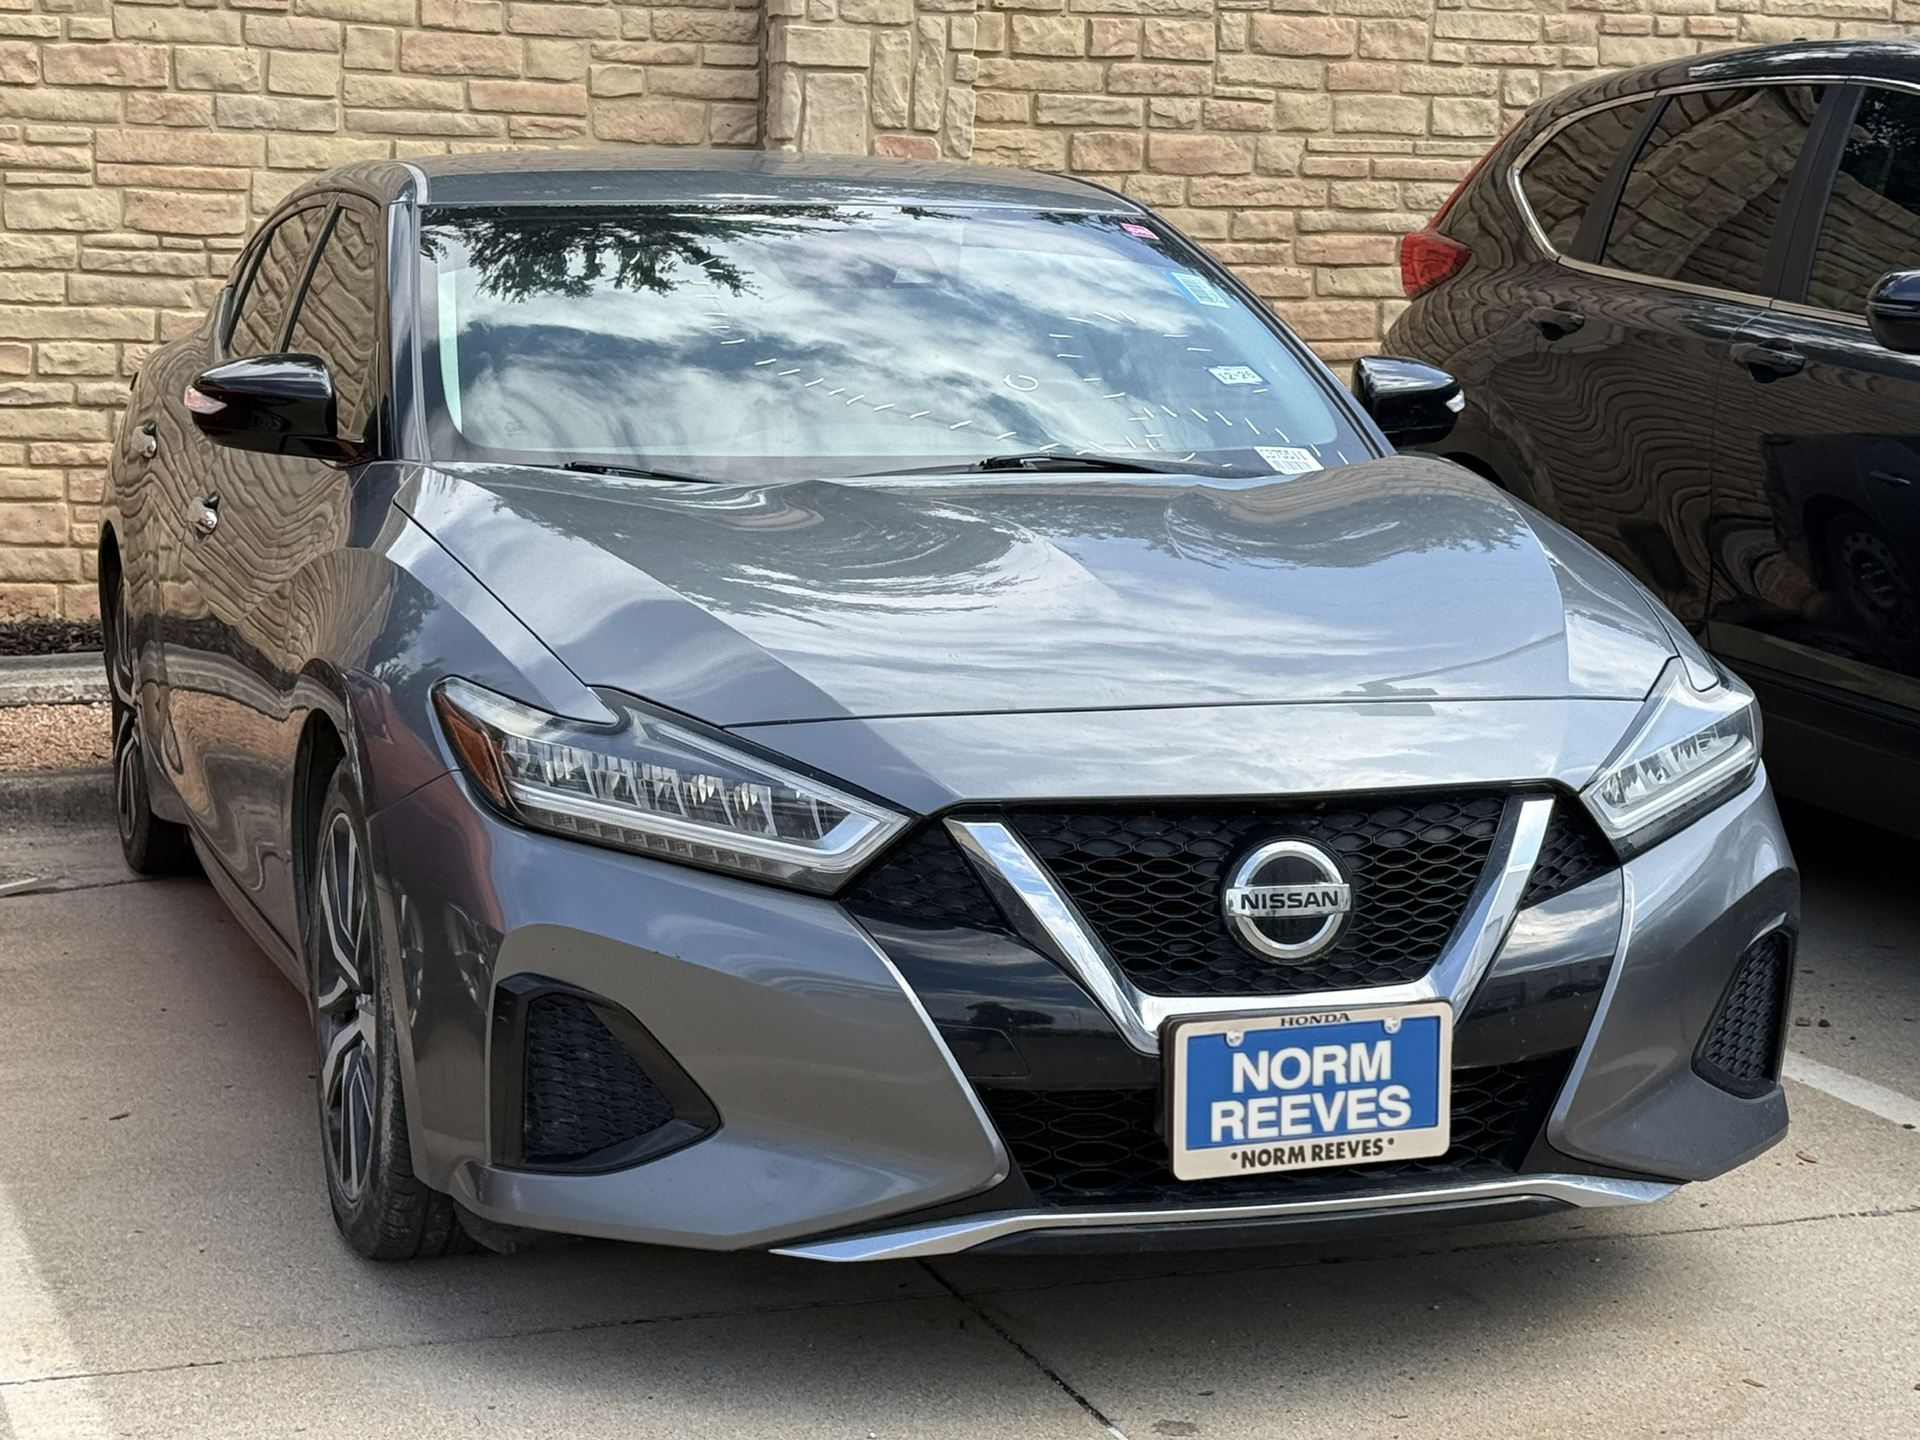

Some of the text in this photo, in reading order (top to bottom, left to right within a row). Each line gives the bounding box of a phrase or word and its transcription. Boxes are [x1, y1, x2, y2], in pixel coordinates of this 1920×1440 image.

[1240, 889, 1339, 910] NISSAN
[1279, 1012, 1352, 1028] HONDA
[1231, 1039, 1392, 1093] NORM
[1210, 1084, 1412, 1143] REEVES
[1240, 1137, 1384, 1170] NORM REEVES
